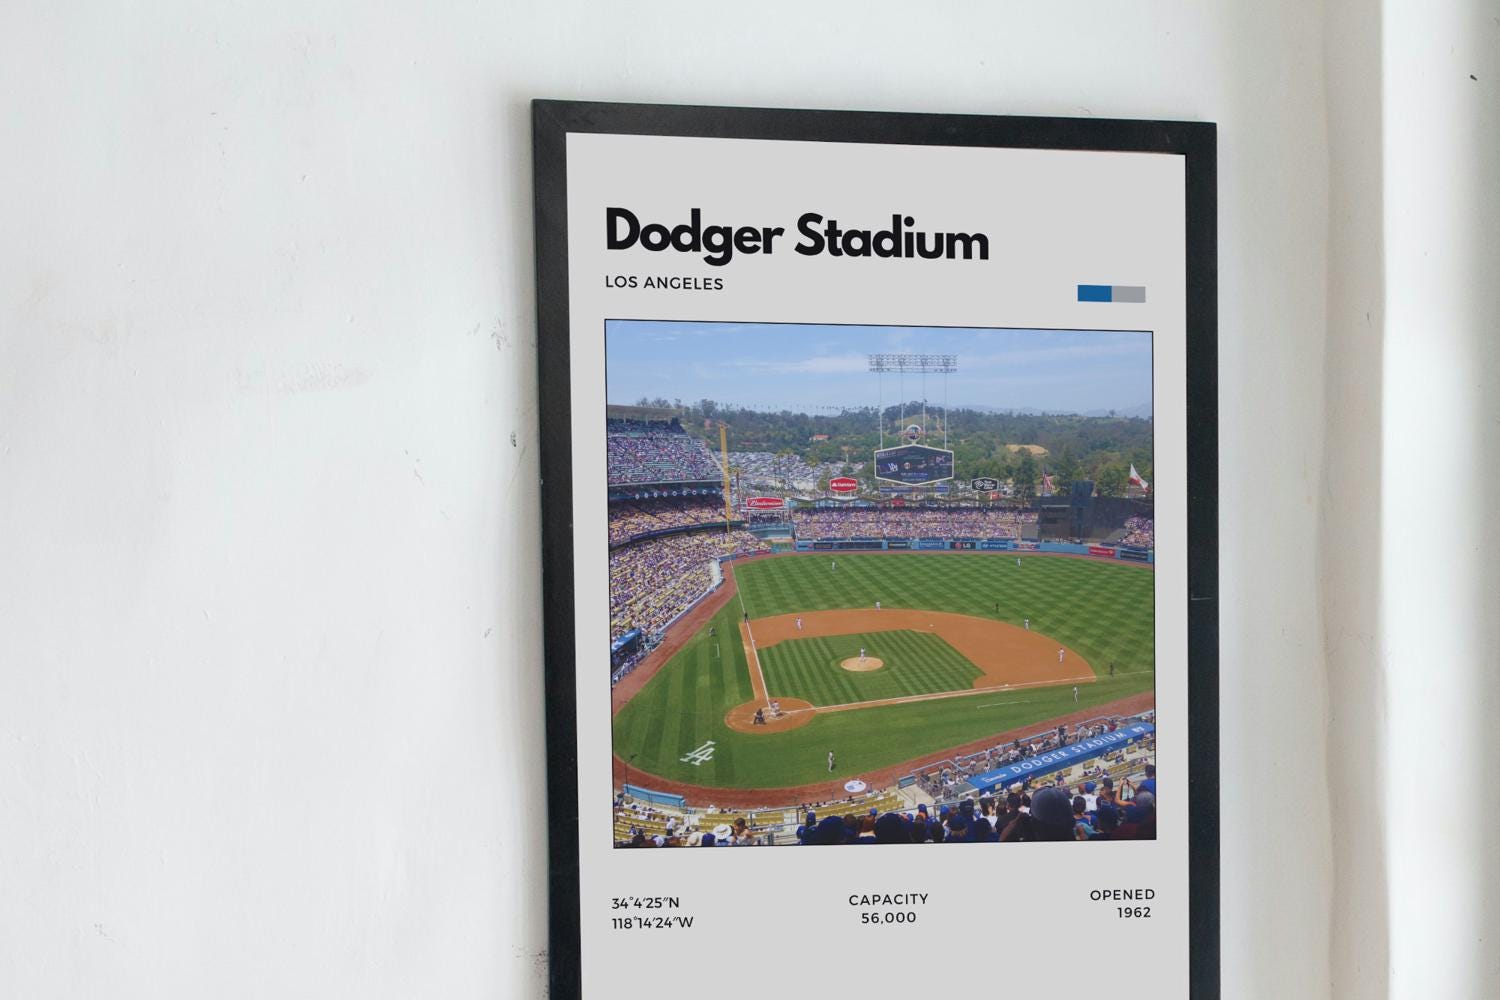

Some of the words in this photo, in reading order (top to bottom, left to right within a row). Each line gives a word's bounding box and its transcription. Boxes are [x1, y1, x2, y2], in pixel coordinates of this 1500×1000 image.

[605, 206, 786, 267] Dodger
[793, 212, 990, 261] Stadium
[605, 274, 638, 289] LOS
[643, 275, 724, 291] ANGELES
[1010, 750, 1070, 774] DODGER
[1071, 732, 1127, 754] STADIUM
[848, 893, 929, 907] CAPACITY
[1089, 888, 1156, 902] OPENED
[861, 911, 917, 925] 56,000
[1116, 906, 1152, 919] 1962
